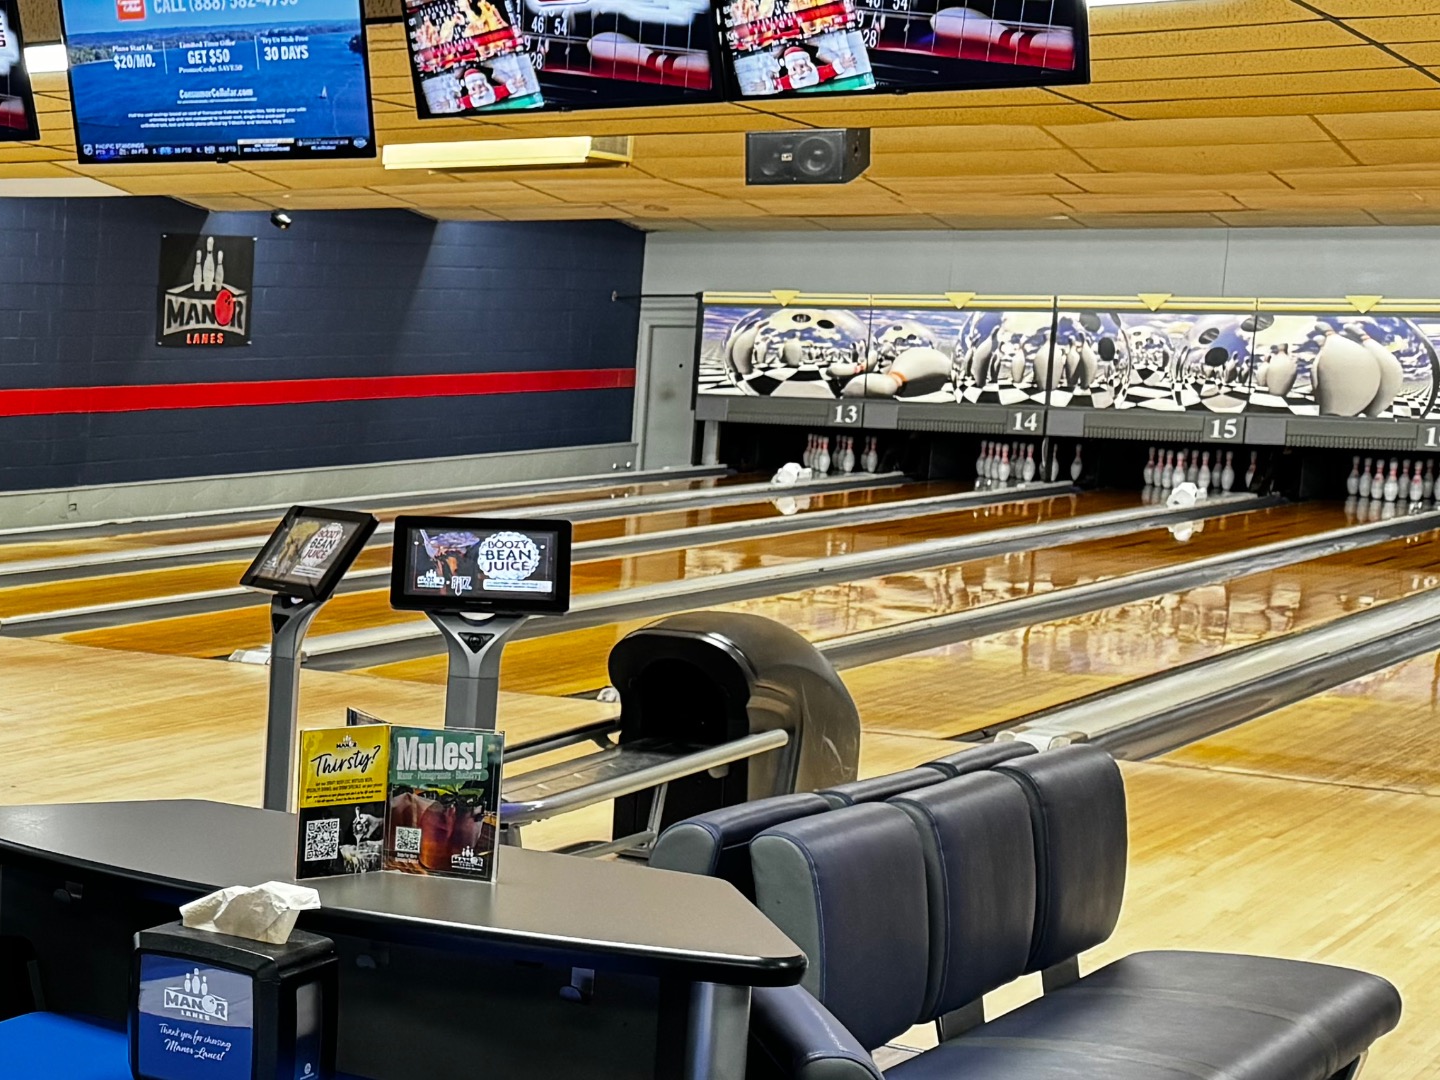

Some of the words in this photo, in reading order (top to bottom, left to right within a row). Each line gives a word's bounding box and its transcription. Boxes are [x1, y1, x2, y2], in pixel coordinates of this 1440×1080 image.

[154, 0, 186, 13] CALL
[531, 16, 544, 34] 46
[554, 18, 568, 36] 54
[187, 50, 207, 65] GET
[208, 47, 231, 66] $50
[263, 46, 280, 61] 30
[280, 44, 309, 60] DAYS
[113, 53, 156, 71] $20/MO.
[166, 290, 244, 329] MANOR
[186, 333, 224, 345] LANES
[833, 404, 858, 424] 13
[1012, 411, 1038, 432] 14
[1210, 418, 1238, 439] 15
[1424, 426, 1440, 448] 1
[309, 538, 337, 550] BEAN
[488, 540, 529, 549] BOOZY
[302, 549, 329, 560] JUICE
[485, 549, 532, 561] BEAN
[486, 561, 531, 573] JUICE
[310, 745, 382, 777] Thirsty?
[396, 735, 484, 771] Mules!
[165, 990, 226, 1018] MANOR
[180, 1009, 211, 1021] LANES
[159, 1023, 181, 1037] Thank
[180, 1031, 193, 1041] you
[192, 1029, 203, 1045] for
[204, 1035, 232, 1051] choosing
[164, 1038, 194, 1055] Manor
[188, 1046, 226, 1061] Lanes!
